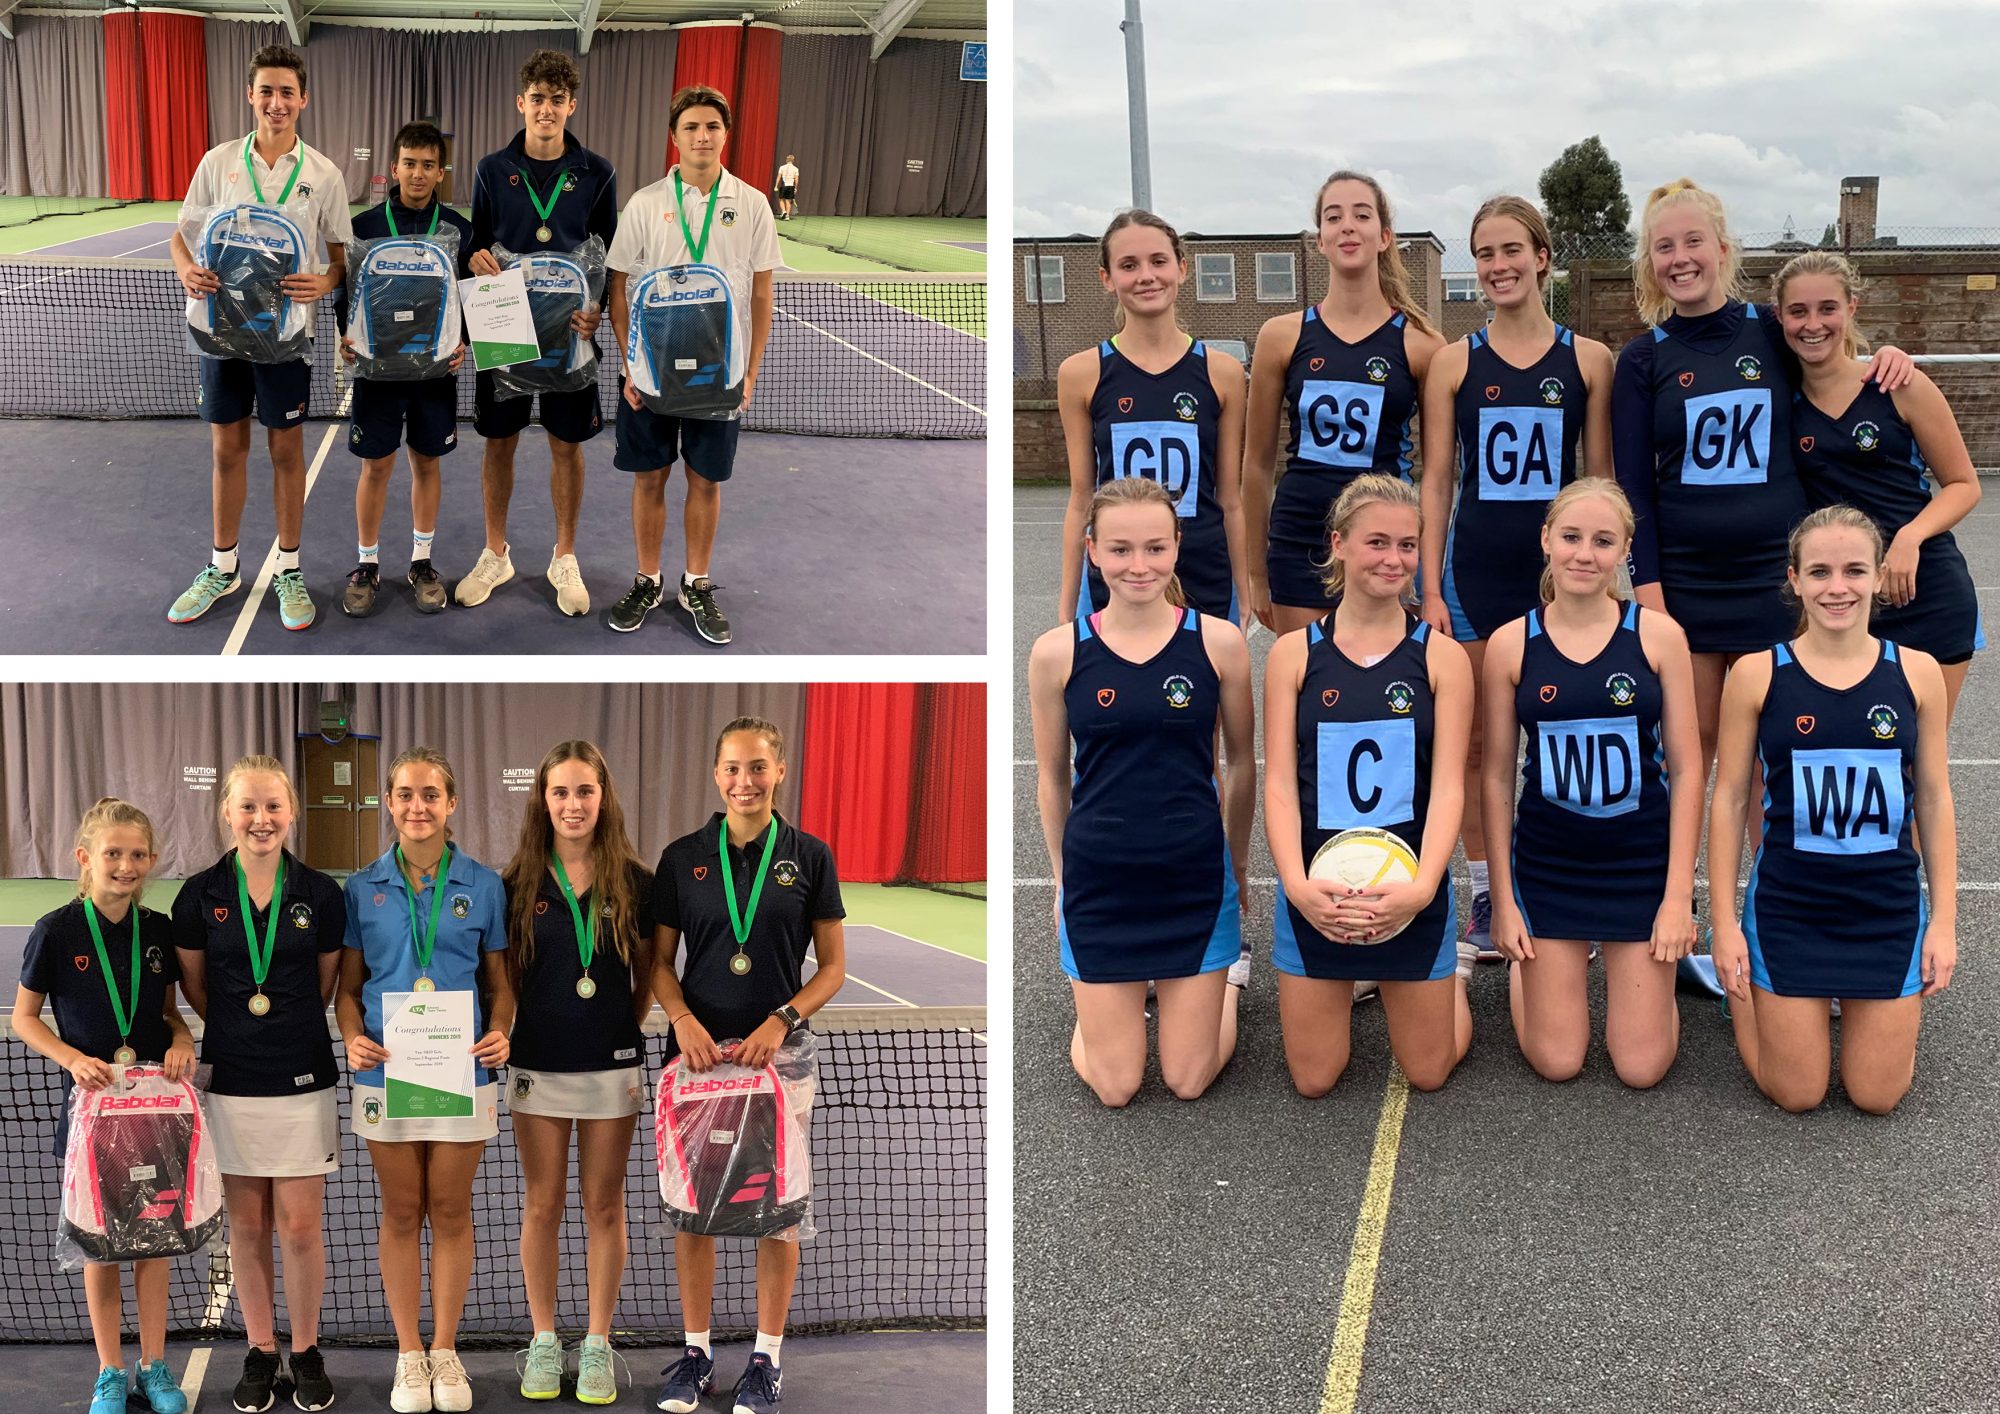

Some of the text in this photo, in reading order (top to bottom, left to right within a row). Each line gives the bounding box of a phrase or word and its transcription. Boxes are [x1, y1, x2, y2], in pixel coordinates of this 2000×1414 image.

[375, 260, 438, 272] Babolat
[525, 278, 575, 289] abolat
[1307, 394, 1371, 453] GS
[1485, 420, 1553, 486] GA
[1692, 403, 1764, 470] GK
[1123, 437, 1192, 502] GD
[183, 767, 217, 775] CAUTION
[502, 768, 535, 776] CAUTION
[1346, 738, 1383, 814] C
[1547, 733, 1632, 807] WD
[1802, 765, 1889, 840] WA
[395, 1025, 461, 1034] Congratulations
[100, 1095, 187, 1111] Babolat
